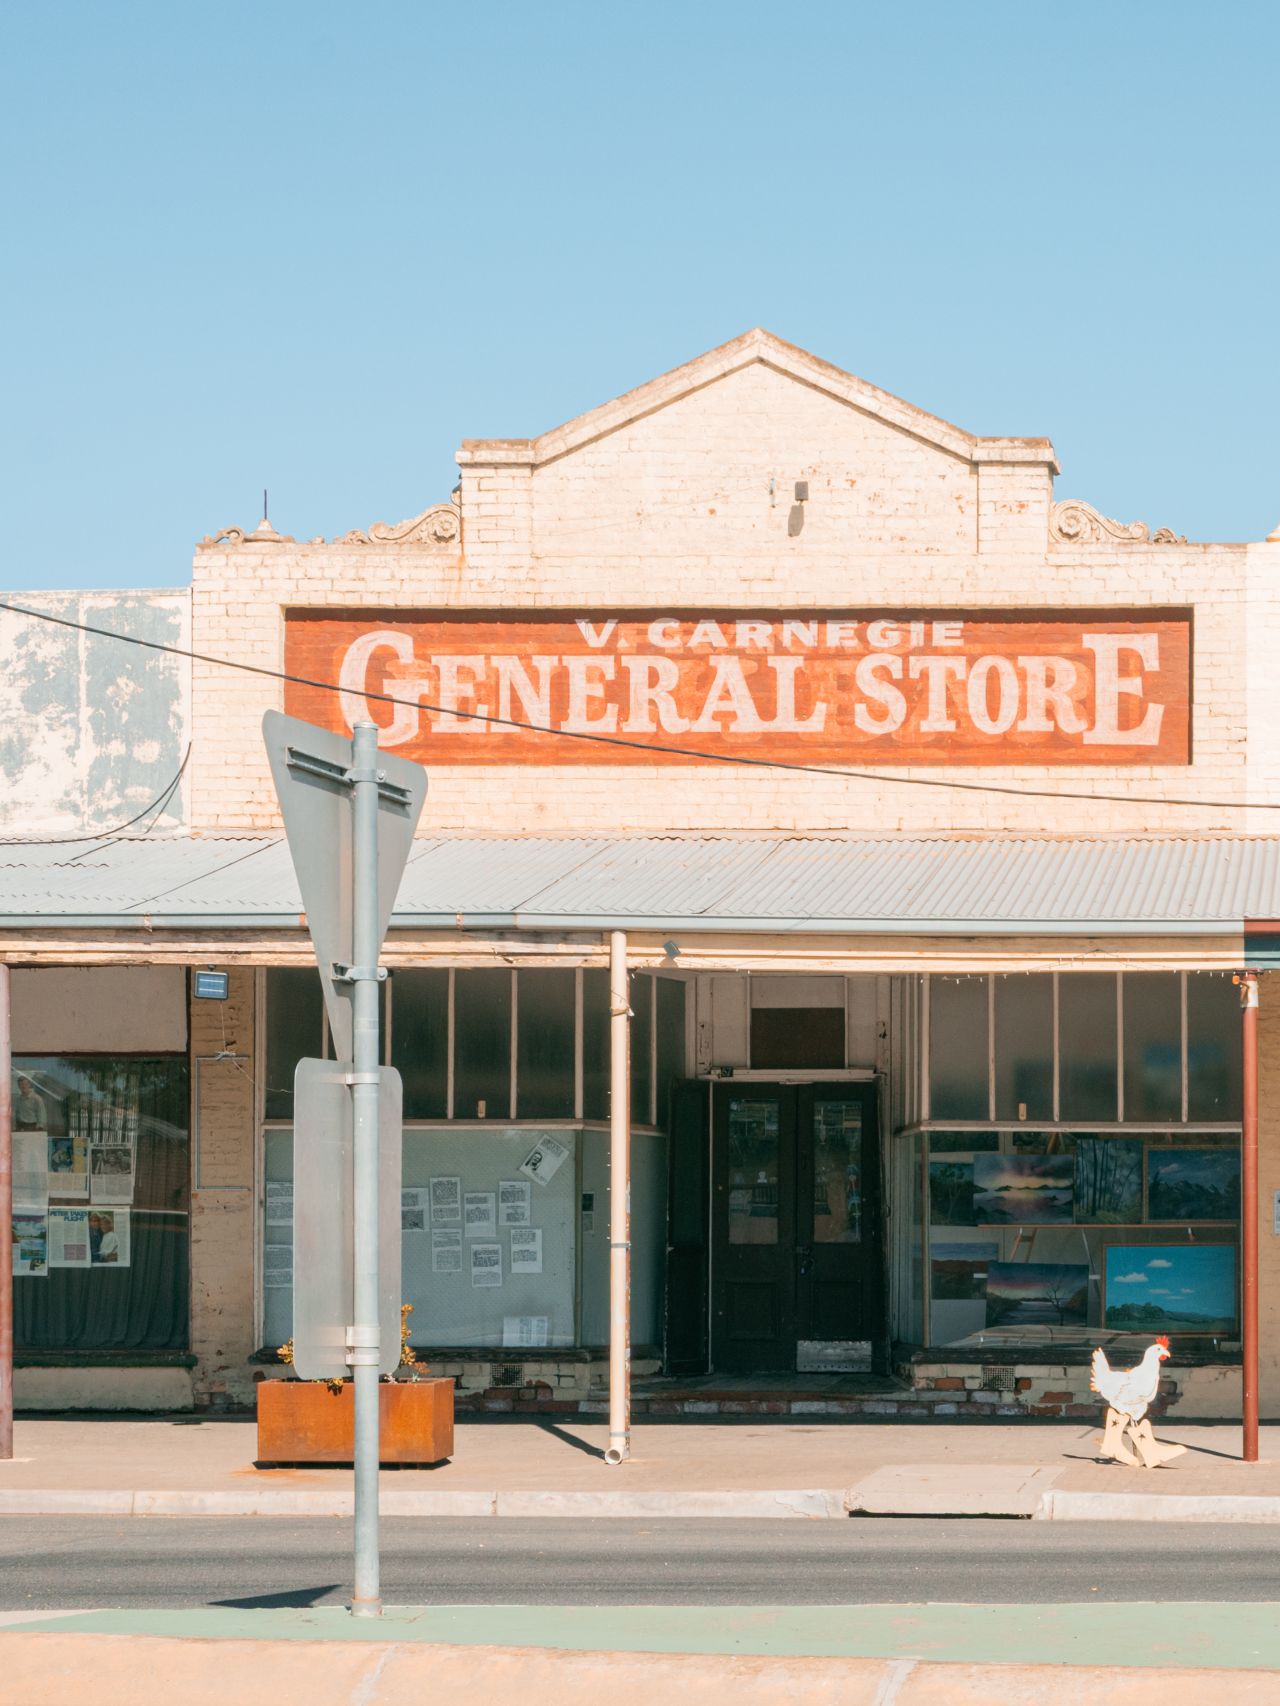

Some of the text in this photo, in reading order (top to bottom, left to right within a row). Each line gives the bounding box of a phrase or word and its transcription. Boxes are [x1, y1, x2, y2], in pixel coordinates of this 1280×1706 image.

[576, 617, 965, 649] V. CARNEGIE
[338, 630, 1165, 747] GENERAL STORE
